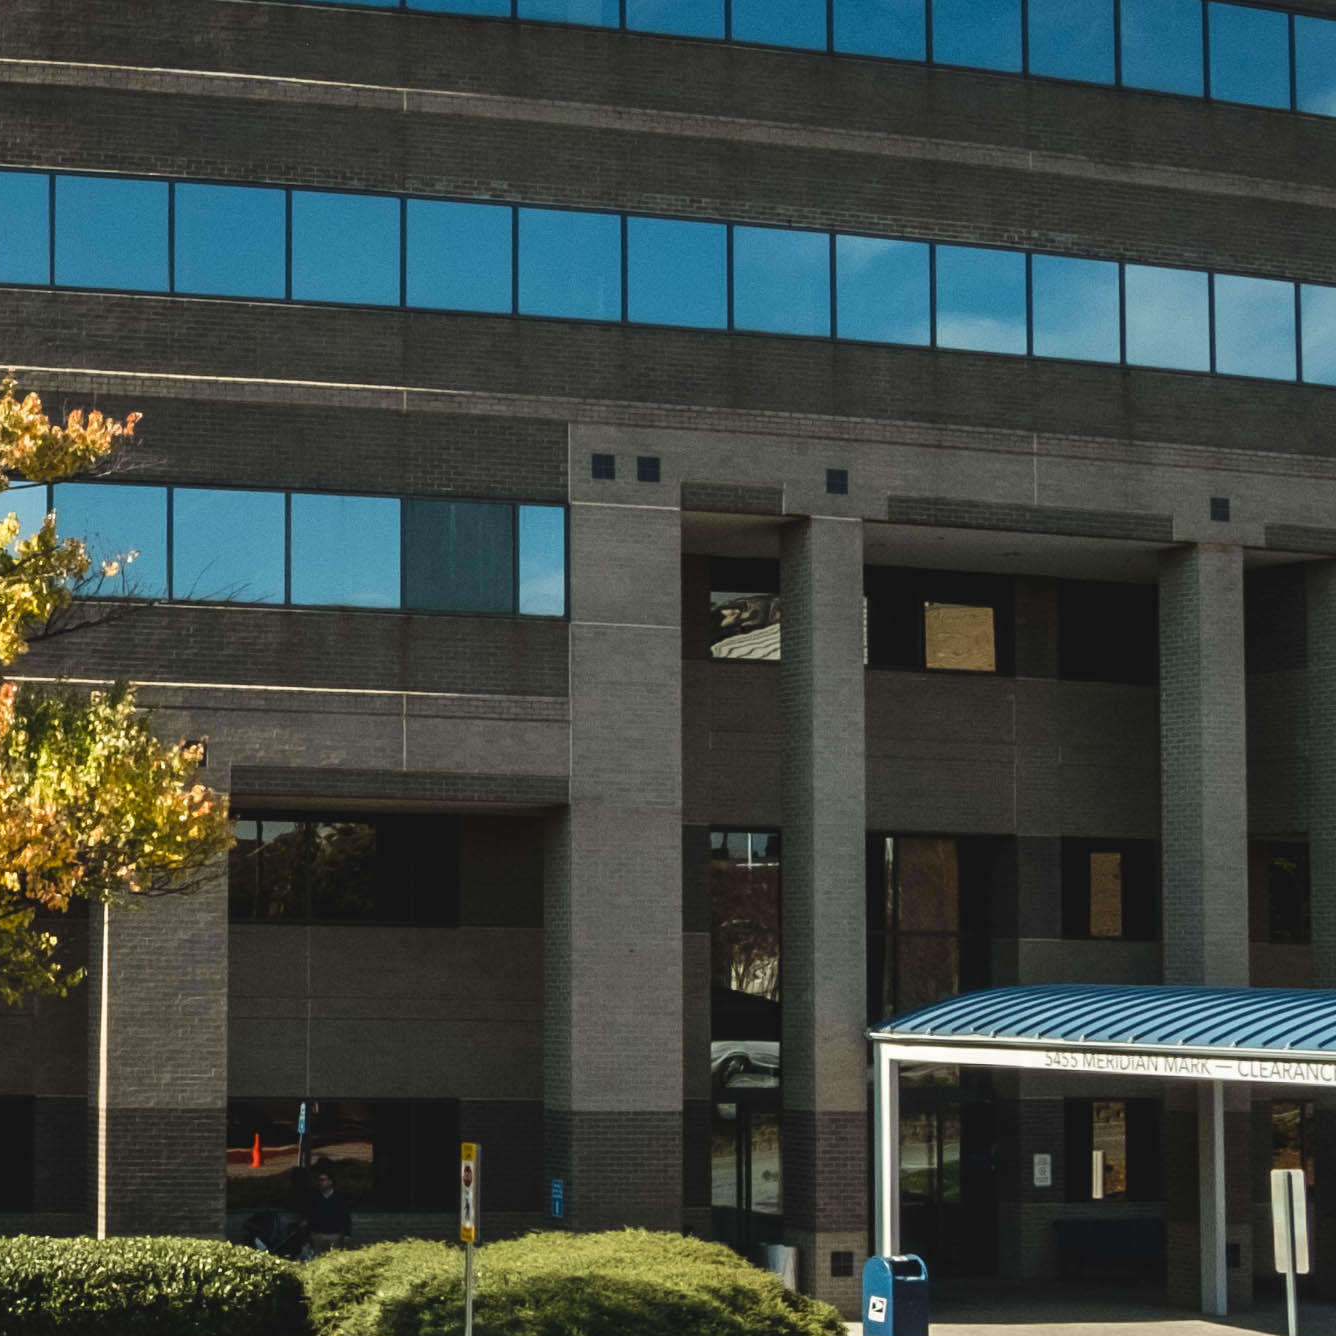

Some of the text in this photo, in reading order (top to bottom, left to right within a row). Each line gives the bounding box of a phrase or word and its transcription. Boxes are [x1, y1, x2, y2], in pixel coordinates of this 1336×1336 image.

[1045, 1052, 1078, 1067] 5455
[1082, 1053, 1158, 1072] MERIDIAN
[1163, 1057, 1212, 1075] MARK
